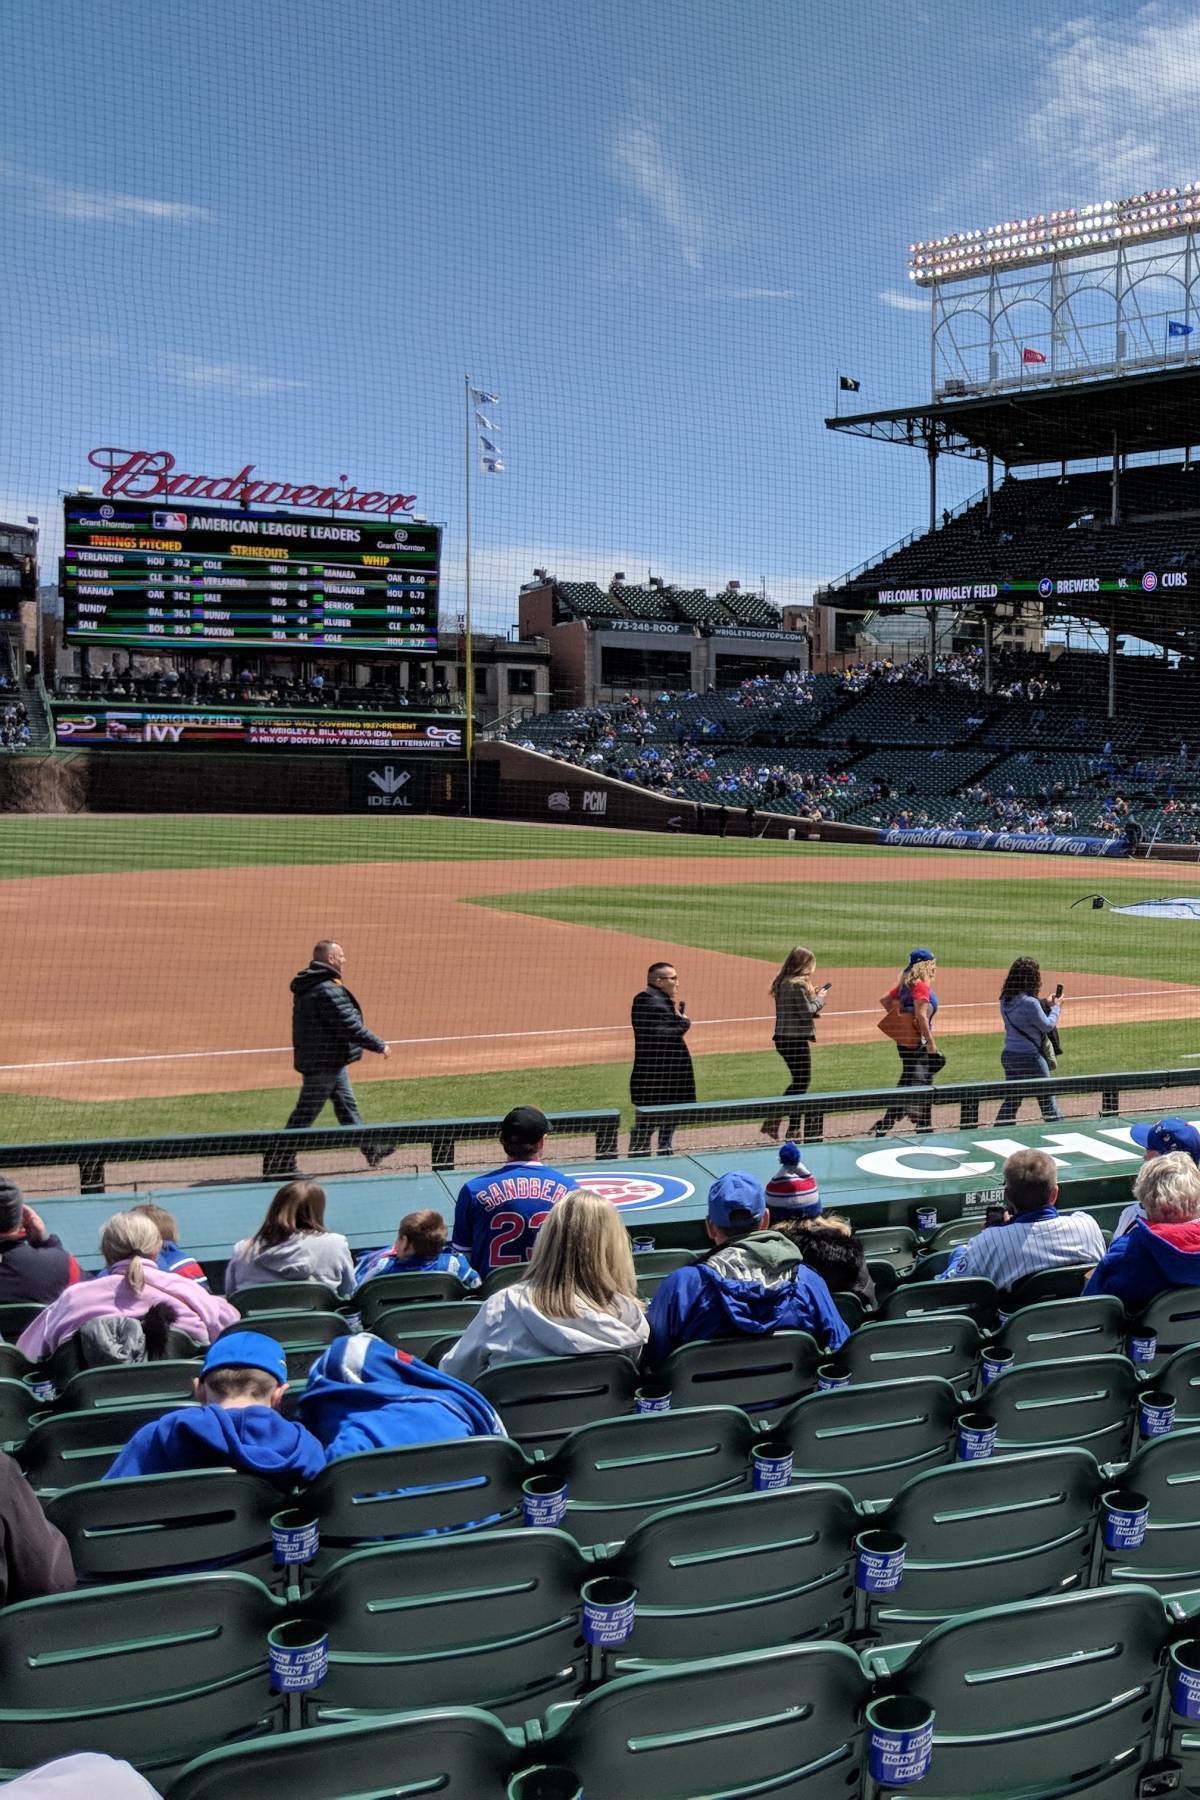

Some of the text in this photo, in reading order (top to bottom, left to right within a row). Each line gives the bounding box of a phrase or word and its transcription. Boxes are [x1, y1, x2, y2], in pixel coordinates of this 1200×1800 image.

[88, 448, 417, 514] Budweiser
[192, 517, 361, 542] AMERICAN LEAGUE LEADERS
[90, 535, 182, 552] INNINGS PITCHED
[230, 544, 288, 559] STRIKEOUTS
[78, 552, 124, 563] VERLANDER
[147, 557, 165, 566] HOU
[362, 556, 390, 566] WHIP
[204, 560, 222, 570] COLE
[270, 565, 288, 574] HOU
[78, 568, 108, 578] KLUBER
[150, 573, 163, 582] CLE
[324, 568, 426, 584] MANAEA OAK 0.60
[271, 582, 288, 590] HOU
[1056, 572, 1188, 594] BREWERS VS. CUBS
[78, 585, 114, 596] MANAEA
[148, 590, 165, 599] OAK
[324, 584, 426, 600] VERLANDER HOU 0.73
[878, 584, 998, 603] WELCOME TO WRIGLEY FIELD
[204, 594, 222, 602] SALE
[272, 598, 288, 606] BOS
[78, 604, 107, 614] BUNDY
[148, 608, 164, 616] BAL
[324, 601, 354, 610] BERRIOS
[387, 606, 402, 614] MIN
[204, 611, 230, 620] BUNDY
[272, 614, 286, 624] BAL
[324, 618, 351, 627] KLUBER
[389, 622, 402, 630] CLE
[78, 620, 98, 630] SALE
[149, 624, 164, 633] BOS
[204, 626, 234, 636] PAXTON
[272, 631, 286, 640] SEA
[612, 621, 680, 633] 773-248-ROOF
[324, 634, 342, 642] COLE
[387, 638, 403, 646] HOU
[715, 628, 801, 641] WRIGLEYROOFTOPS.COM
[148, 714, 242, 726] WRIGLEY FIELD
[294, 720, 318, 728] WALL
[320, 720, 362, 728] COVERING
[362, 722, 417, 730] 1937-PRESENT
[146, 726, 184, 742] IVY
[270, 728, 308, 736] WRIGLEY
[349, 738, 390, 746] JAPANESE
[391, 739, 444, 748] BITTERSWEET
[368, 796, 412, 806] IDEAL
[582, 792, 607, 811] PCM
[885, 830, 936, 846] Reynolds
[936, 831, 968, 847] Wrap
[994, 836, 1050, 852] Reynolds
[1050, 837, 1087, 854] Wrap
[476, 1177, 568, 1212] SANDBER
[966, 1190, 1006, 1204] BE ALERT
[862, 1556, 882, 1567] Hefty
[868, 1570, 890, 1578] Hefty
[592, 1622, 617, 1630] Hefty
[603, 1630, 626, 1639] Hefty
[297, 1650, 321, 1663] Hefty
[276, 1666, 301, 1675] Hefty
[286, 1676, 312, 1685] Hefty
[873, 1736, 900, 1750] Hefty
[885, 1754, 913, 1764] Hefty
[898, 1762, 923, 1777] Hefty
